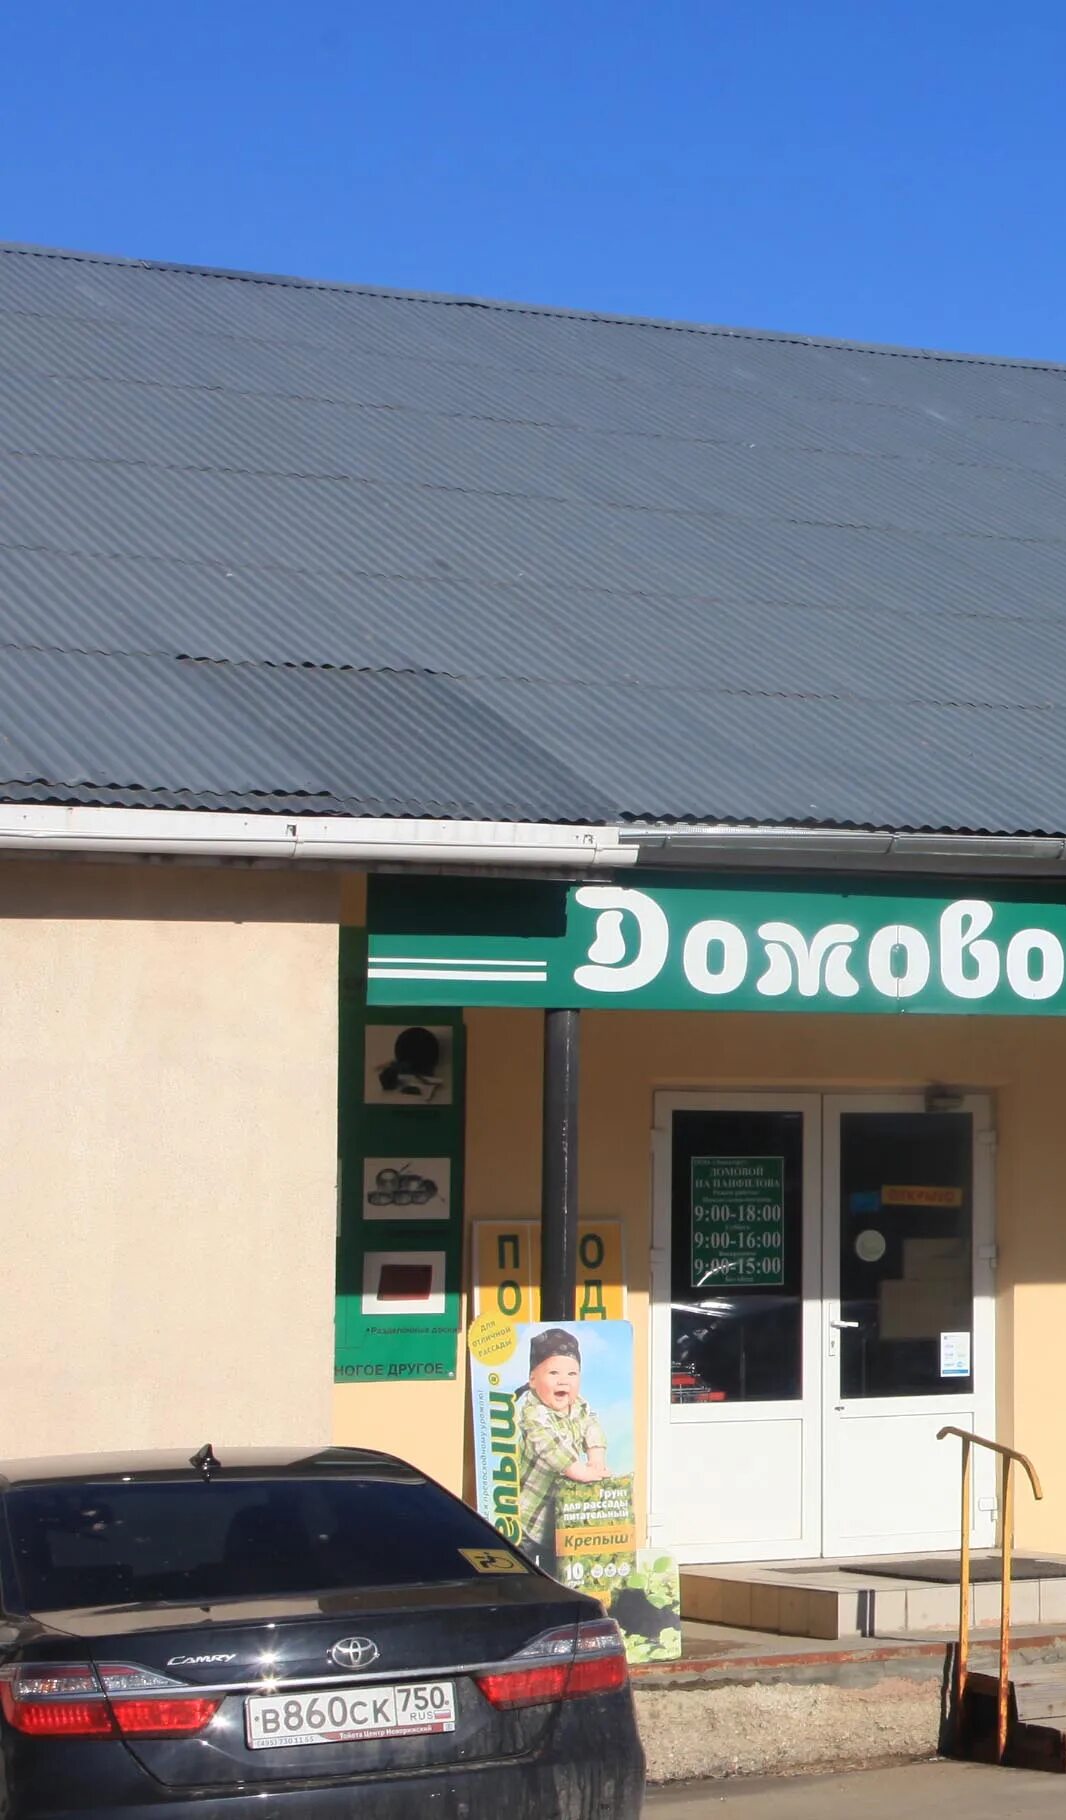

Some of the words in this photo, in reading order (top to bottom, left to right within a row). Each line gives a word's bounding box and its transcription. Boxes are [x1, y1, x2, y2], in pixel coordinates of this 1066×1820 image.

[694, 1204, 781, 1222] 9:00-18:00
[694, 1231, 781, 1249] 9:00-16:00
[694, 1257, 781, 1275] 9:00-15:00
[335, 1364, 384, 1377] НОГОЕ
[489, 1391, 520, 1547] епыш
[599, 1488, 628, 1501] Грунт
[583, 1499, 629, 1512] рассады
[563, 1508, 629, 1522] питательный
[564, 1533, 629, 1551] Крепыш
[564, 1562, 584, 1581] 10
[166, 1652, 238, 1666] CAMRY
[260, 1696, 391, 1734] В860СК
[396, 1686, 446, 1712] 750
[409, 1711, 433, 1721] RUS
[364, 1729, 386, 1738] Центр
